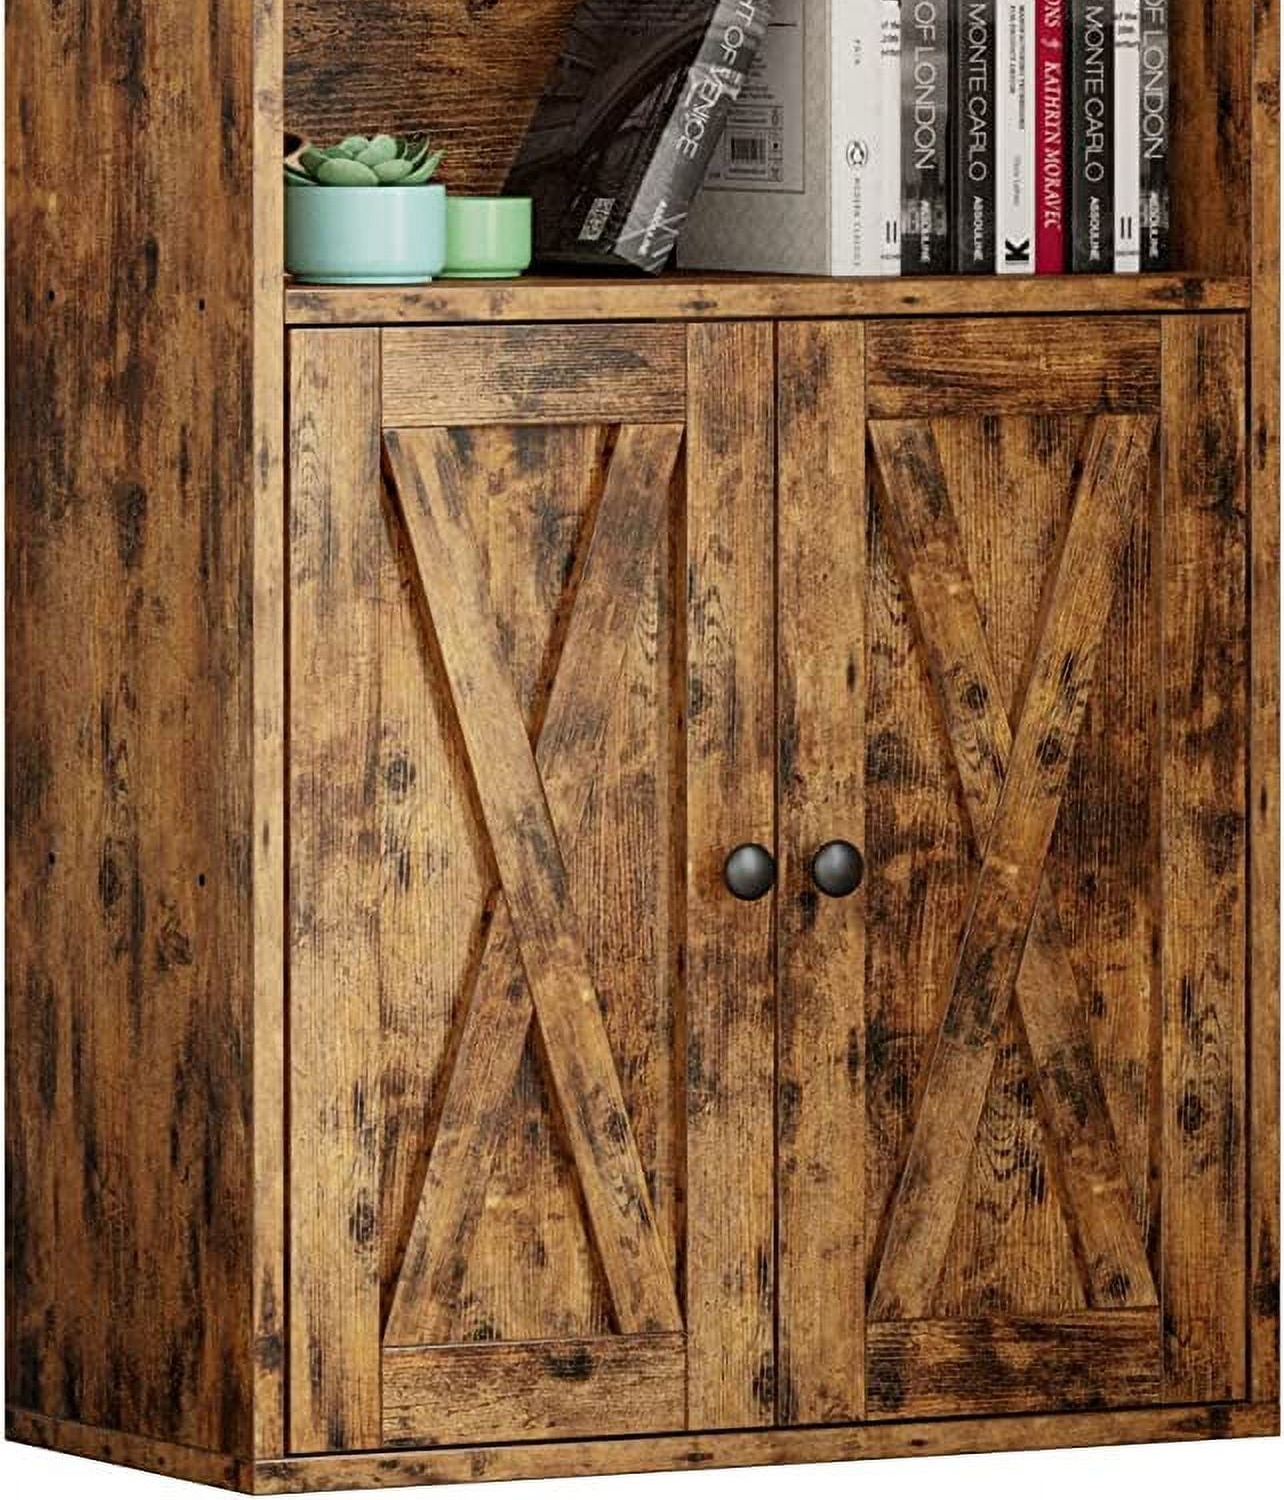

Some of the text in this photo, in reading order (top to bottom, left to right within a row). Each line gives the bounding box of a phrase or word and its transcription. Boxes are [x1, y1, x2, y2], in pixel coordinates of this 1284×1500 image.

[720, 26, 744, 65] OF
[914, 0, 936, 43] OF
[969, 4, 987, 92] MONTE
[1085, 6, 1104, 95] MONTE
[676, 66, 724, 158] VENICE
[914, 46, 936, 170] LONDON
[1044, 61, 1061, 145] KATHRYN
[1143, 30, 1165, 159] LONDON
[969, 95, 987, 182] CARLO
[1085, 97, 1104, 182] CARLO
[973, 195, 984, 261] ASSOULINE
[1044, 147, 1061, 230] MORAVEC
